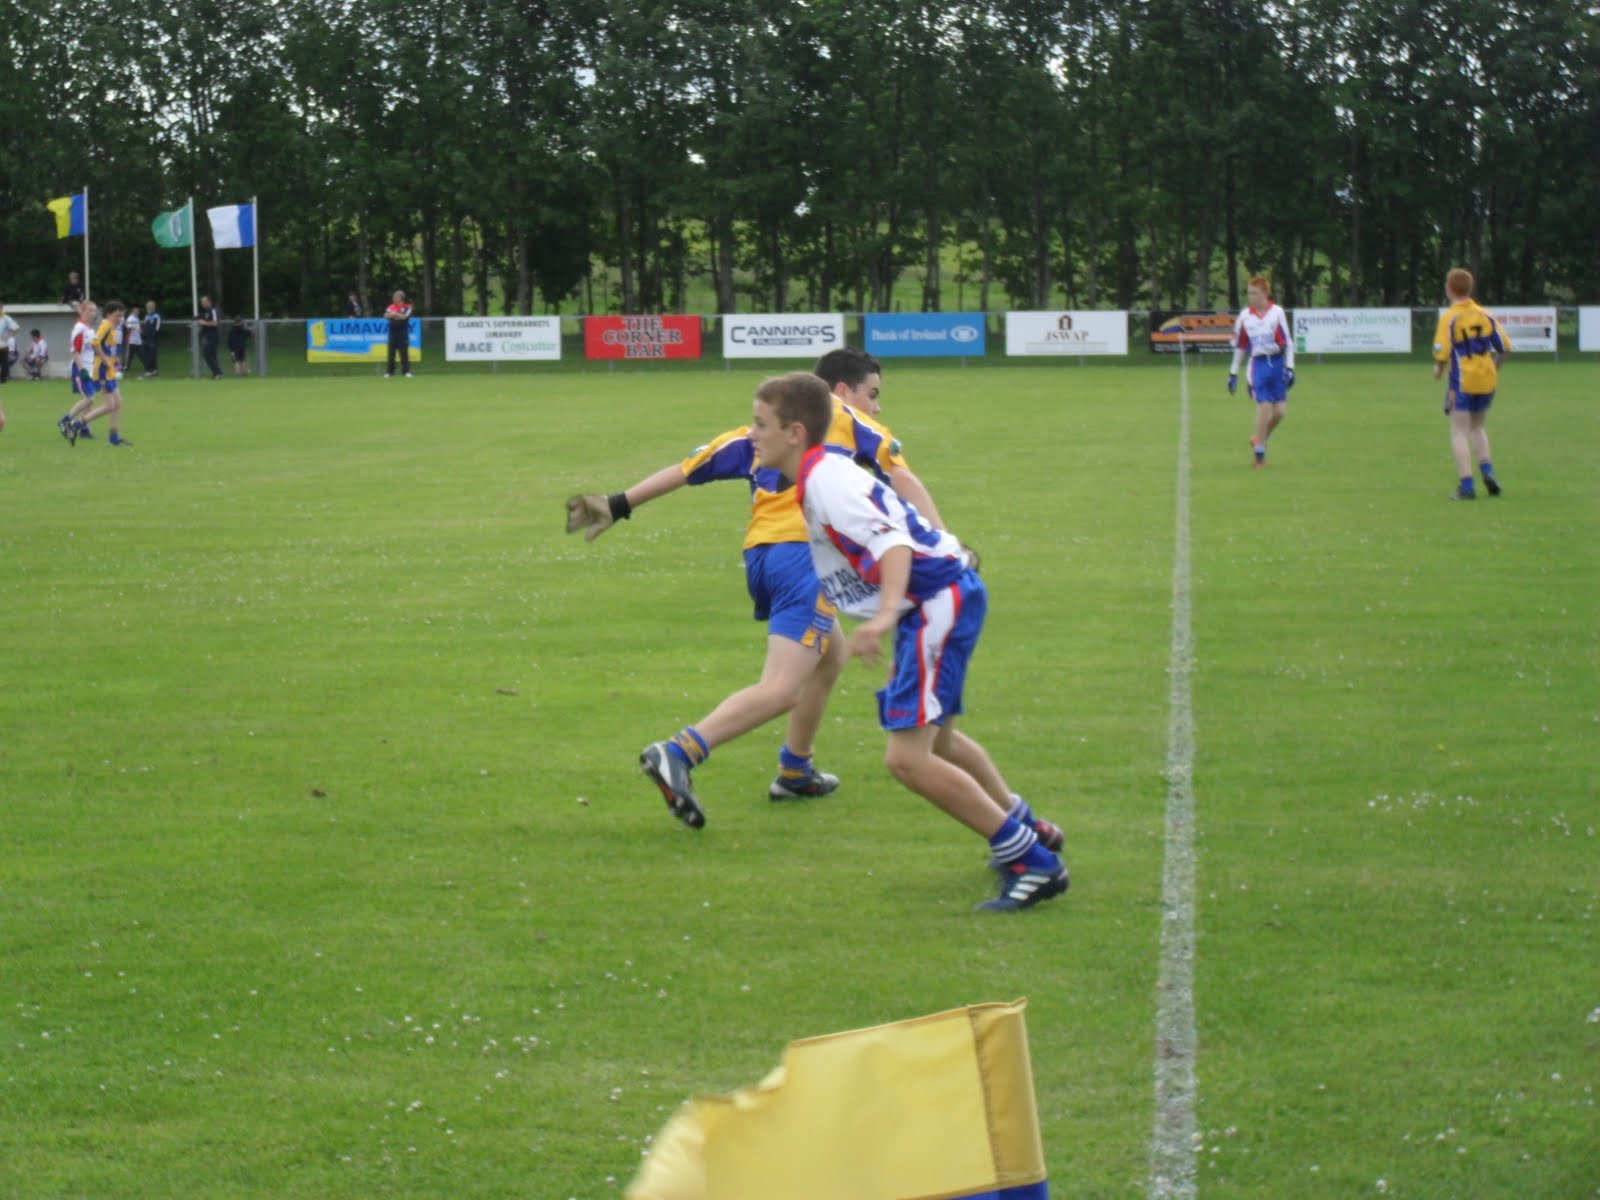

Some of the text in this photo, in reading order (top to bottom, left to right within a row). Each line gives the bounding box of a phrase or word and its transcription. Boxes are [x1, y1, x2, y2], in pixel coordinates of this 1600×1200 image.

[457, 319, 550, 329] CLARKE'S SUPERMARKETS
[623, 316, 661, 330] THE
[1296, 311, 1410, 335] gormley pharmacy
[485, 330, 522, 338] LIMAVADY
[603, 329, 683, 344] CORNER
[730, 325, 836, 343] CANNINGS
[872, 328, 947, 341] Bank of Ireland
[455, 341, 493, 353] MACE
[501, 341, 557, 353] Costcutter
[624, 343, 665, 358] BAR
